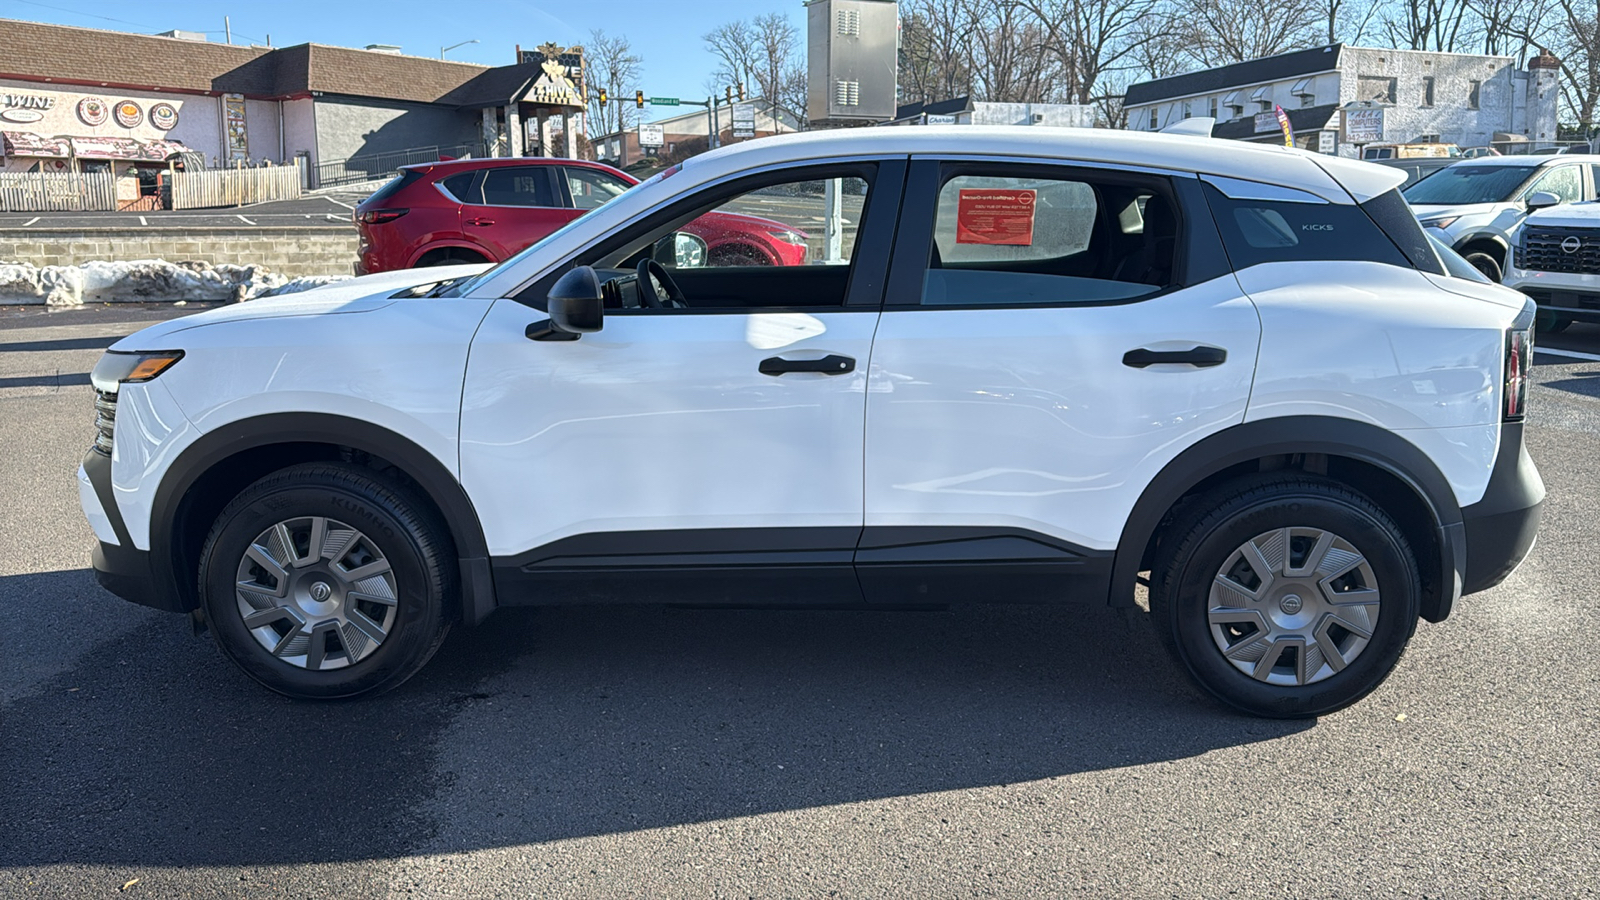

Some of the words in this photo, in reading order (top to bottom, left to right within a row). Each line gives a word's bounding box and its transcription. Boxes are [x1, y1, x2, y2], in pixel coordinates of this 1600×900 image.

[10, 95, 56, 109] WINE
[1347, 118, 1382, 126] COMPUTERS
[1346, 133, 1382, 141] 942-9700
[330, 496, 395, 538] KUMHO
